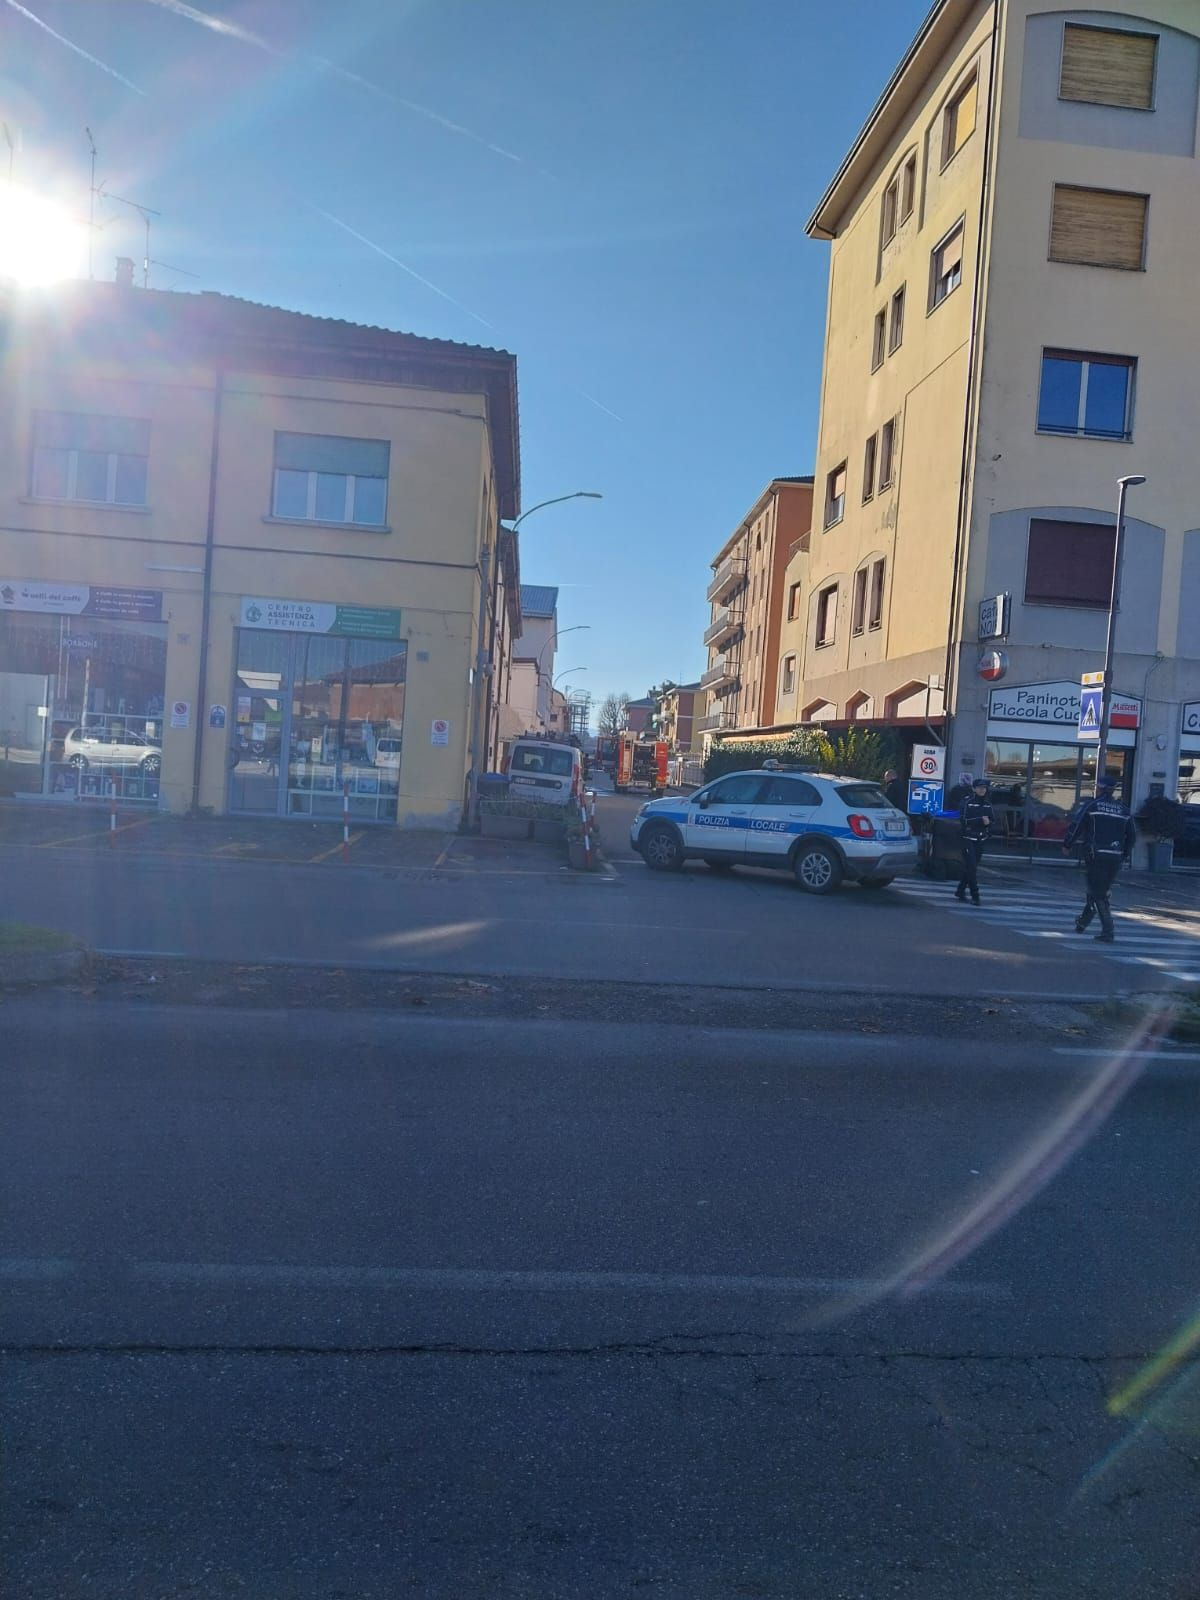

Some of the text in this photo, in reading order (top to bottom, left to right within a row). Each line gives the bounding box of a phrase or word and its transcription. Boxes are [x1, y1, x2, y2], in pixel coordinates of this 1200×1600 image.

[267, 603, 311, 612] CENTRO
[267, 611, 314, 620] ASSISTENZA
[267, 619, 315, 627] TECNICA
[980, 621, 997, 636] NOI
[1017, 691, 1080, 707] Paninot
[993, 702, 1080, 720] Piccola Cuc
[924, 761, 933, 770] 30
[698, 815, 786, 832] POLIZIA LOCALE
